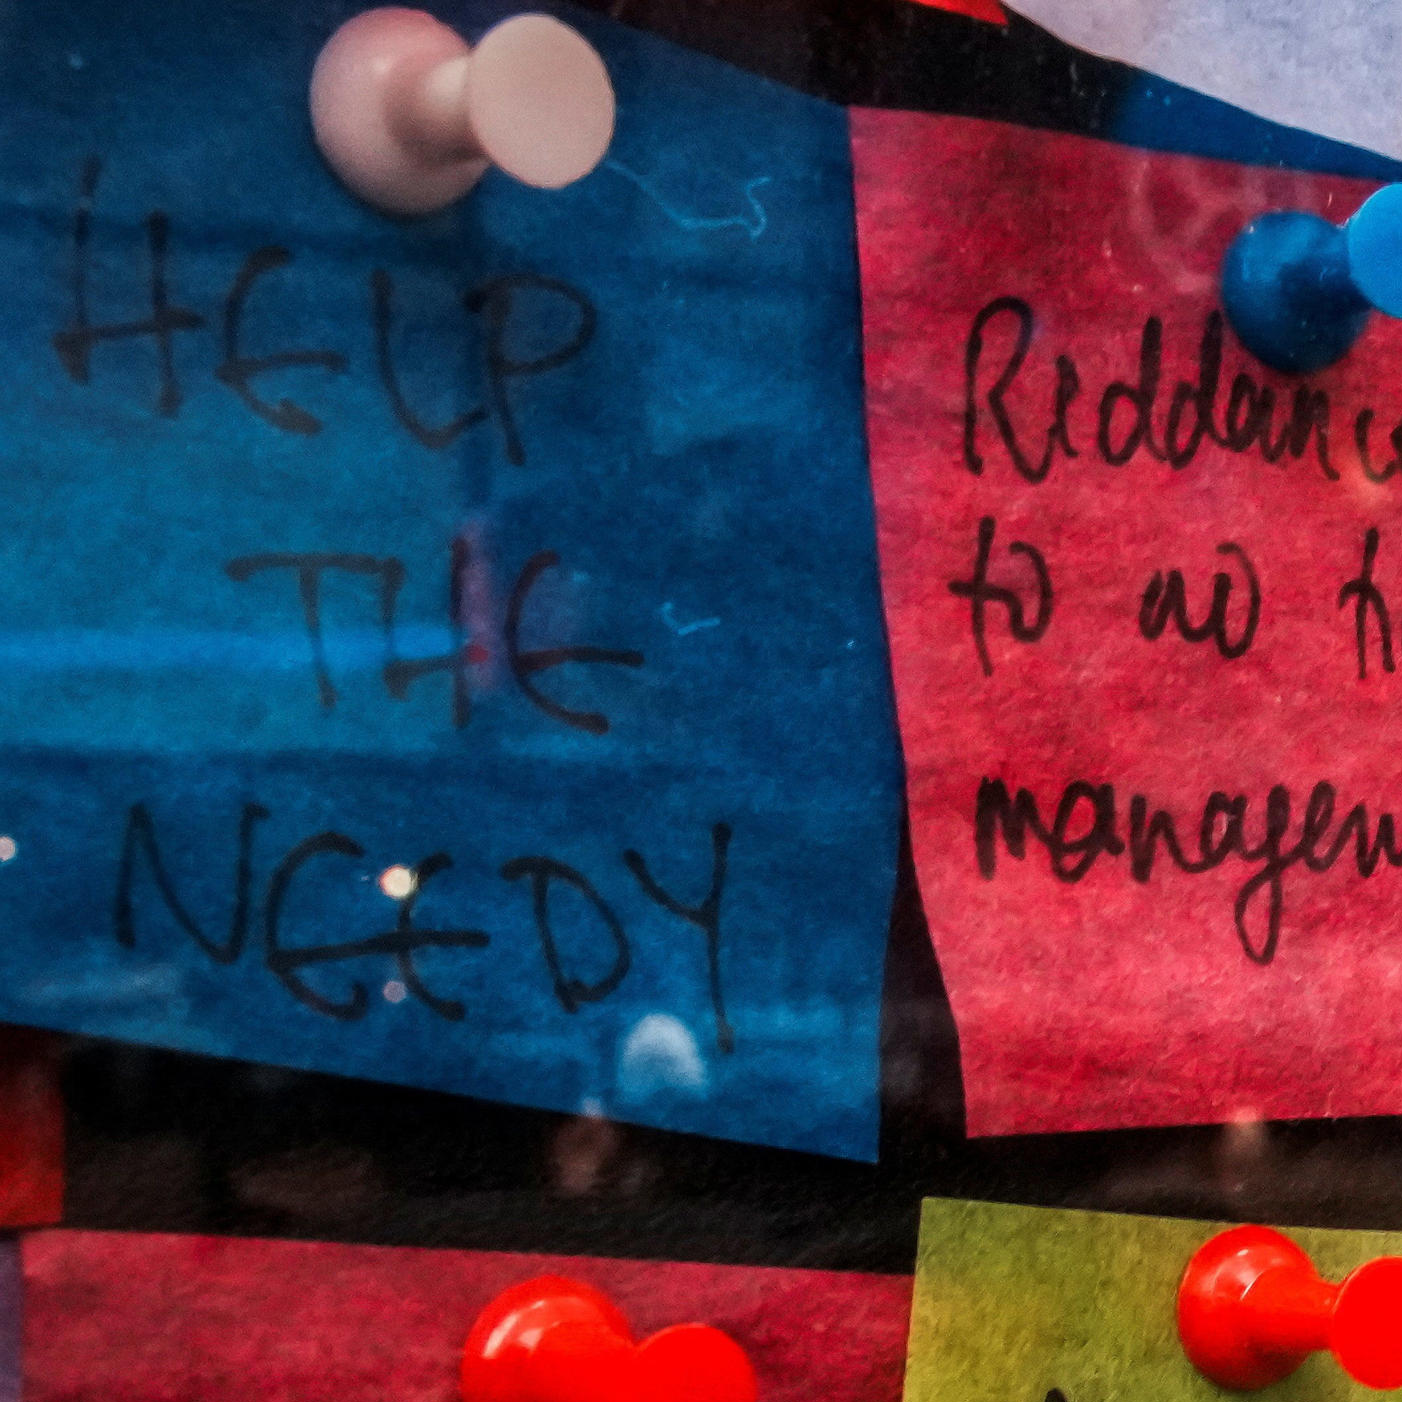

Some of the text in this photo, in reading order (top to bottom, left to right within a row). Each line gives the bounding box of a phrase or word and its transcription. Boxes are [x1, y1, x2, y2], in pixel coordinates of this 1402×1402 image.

[52, 156, 598, 464] HELP
[225, 536, 644, 733] THE
[949, 517, 1054, 676] to
[112, 802, 734, 1054] NEEDY
